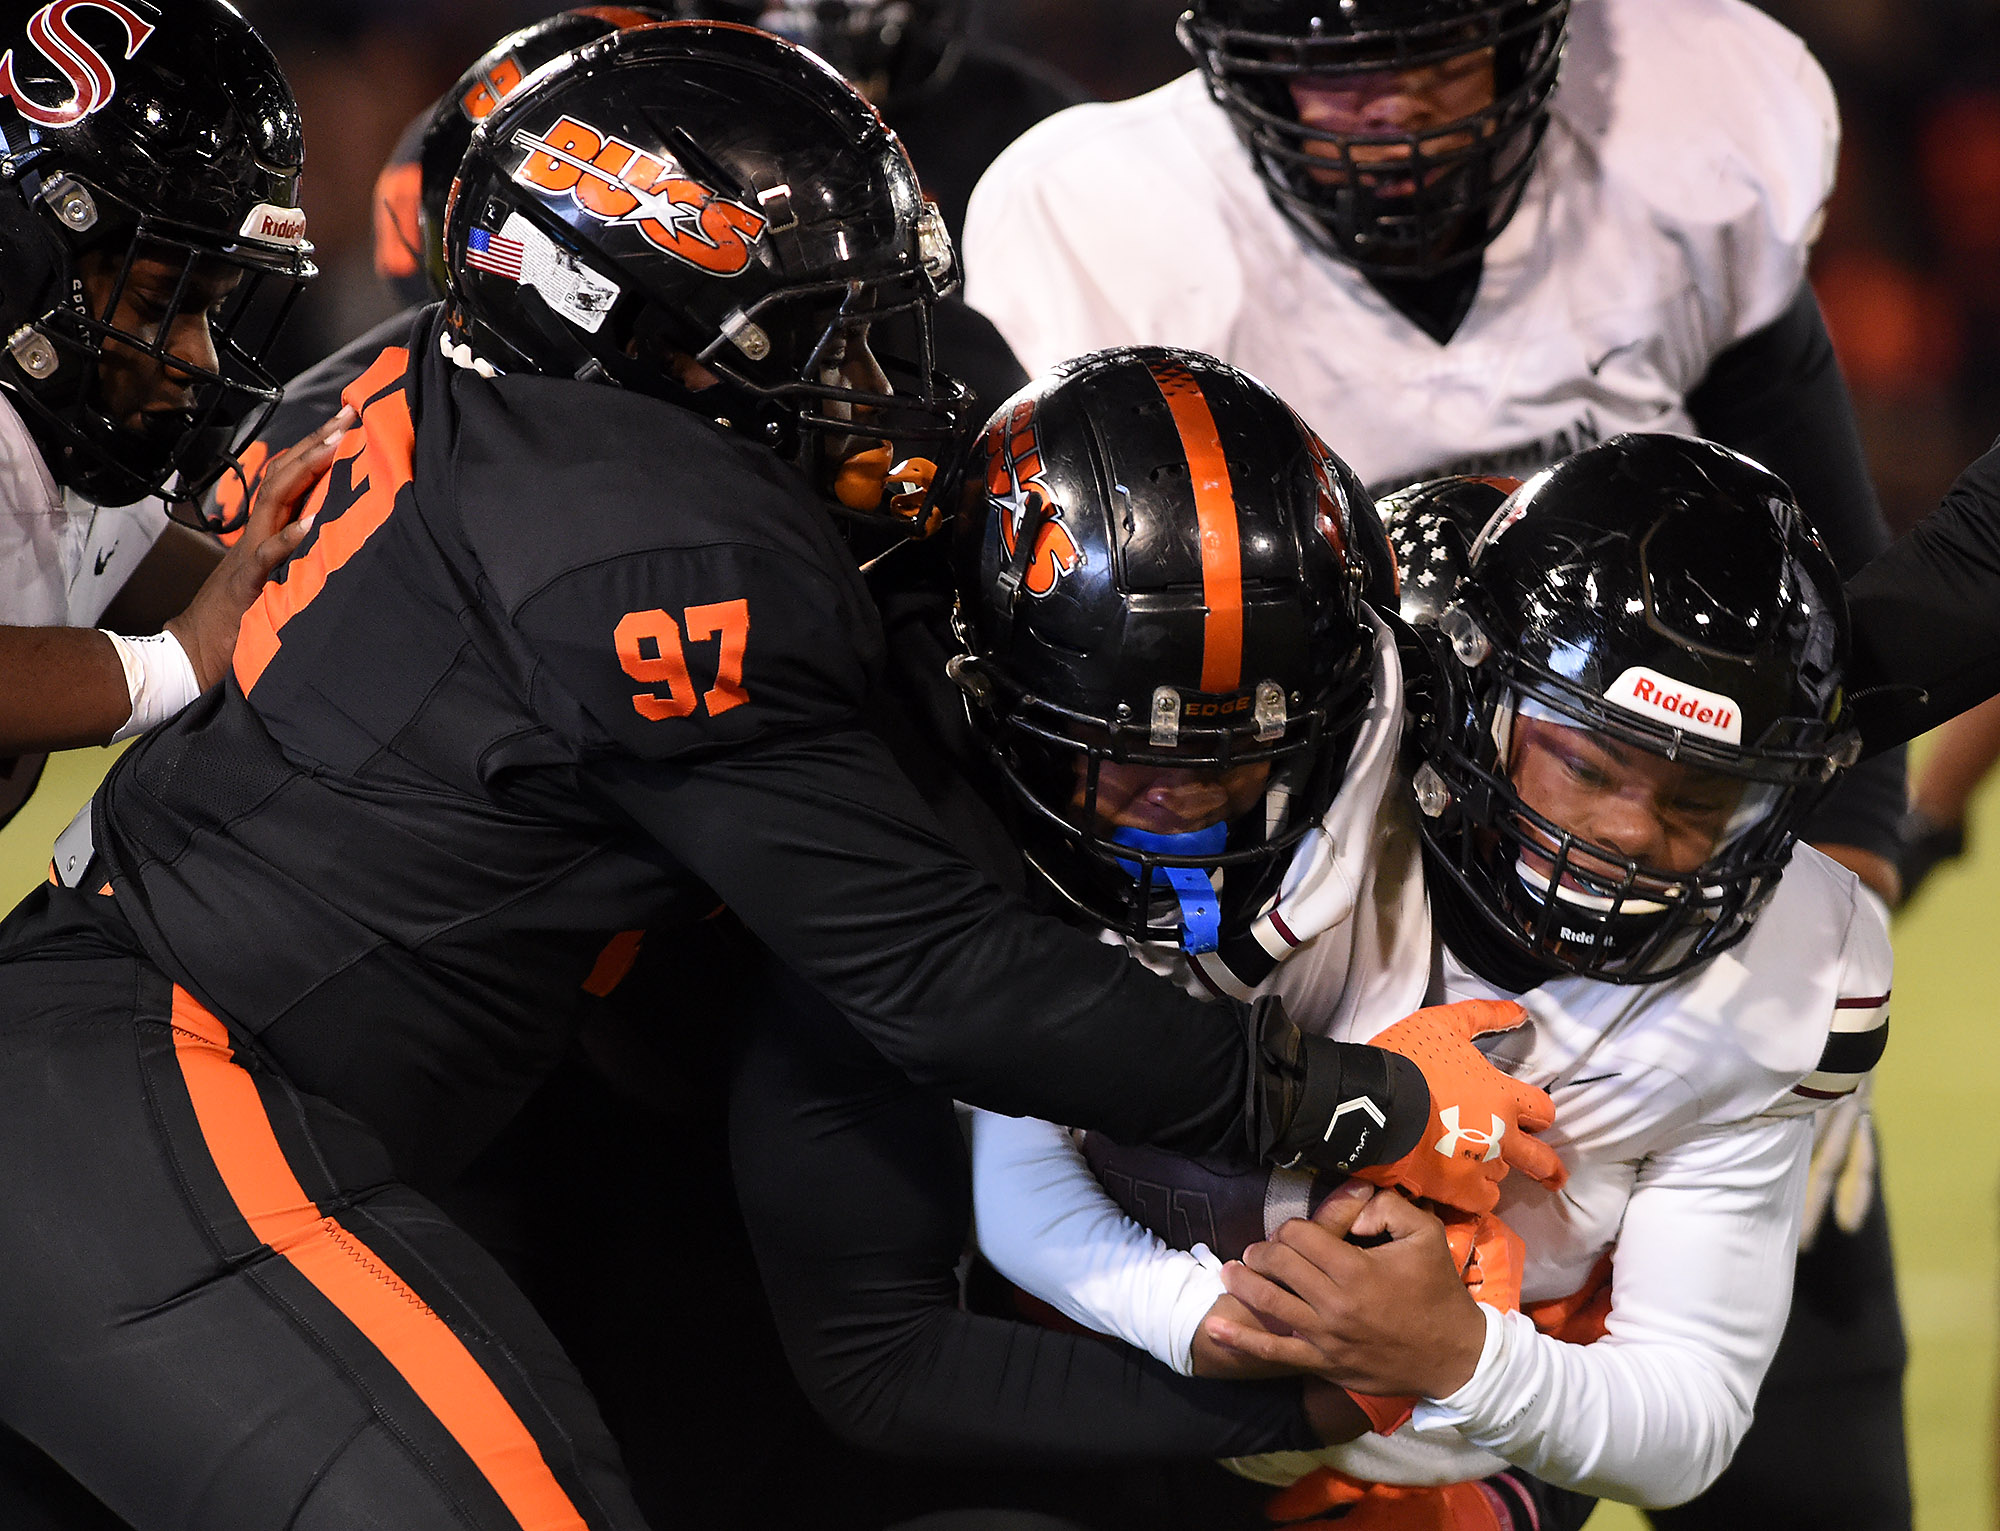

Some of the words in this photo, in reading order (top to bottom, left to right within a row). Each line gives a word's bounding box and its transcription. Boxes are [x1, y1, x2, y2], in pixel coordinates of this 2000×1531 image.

[0, 0, 155, 128] S
[511, 114, 769, 278] BUCS
[261, 214, 305, 239] Ridde
[613, 598, 750, 722] 97
[1185, 696, 1251, 717] EDGE
[1633, 677, 1732, 729] Riddell
[1560, 926, 1613, 946] Riddll
